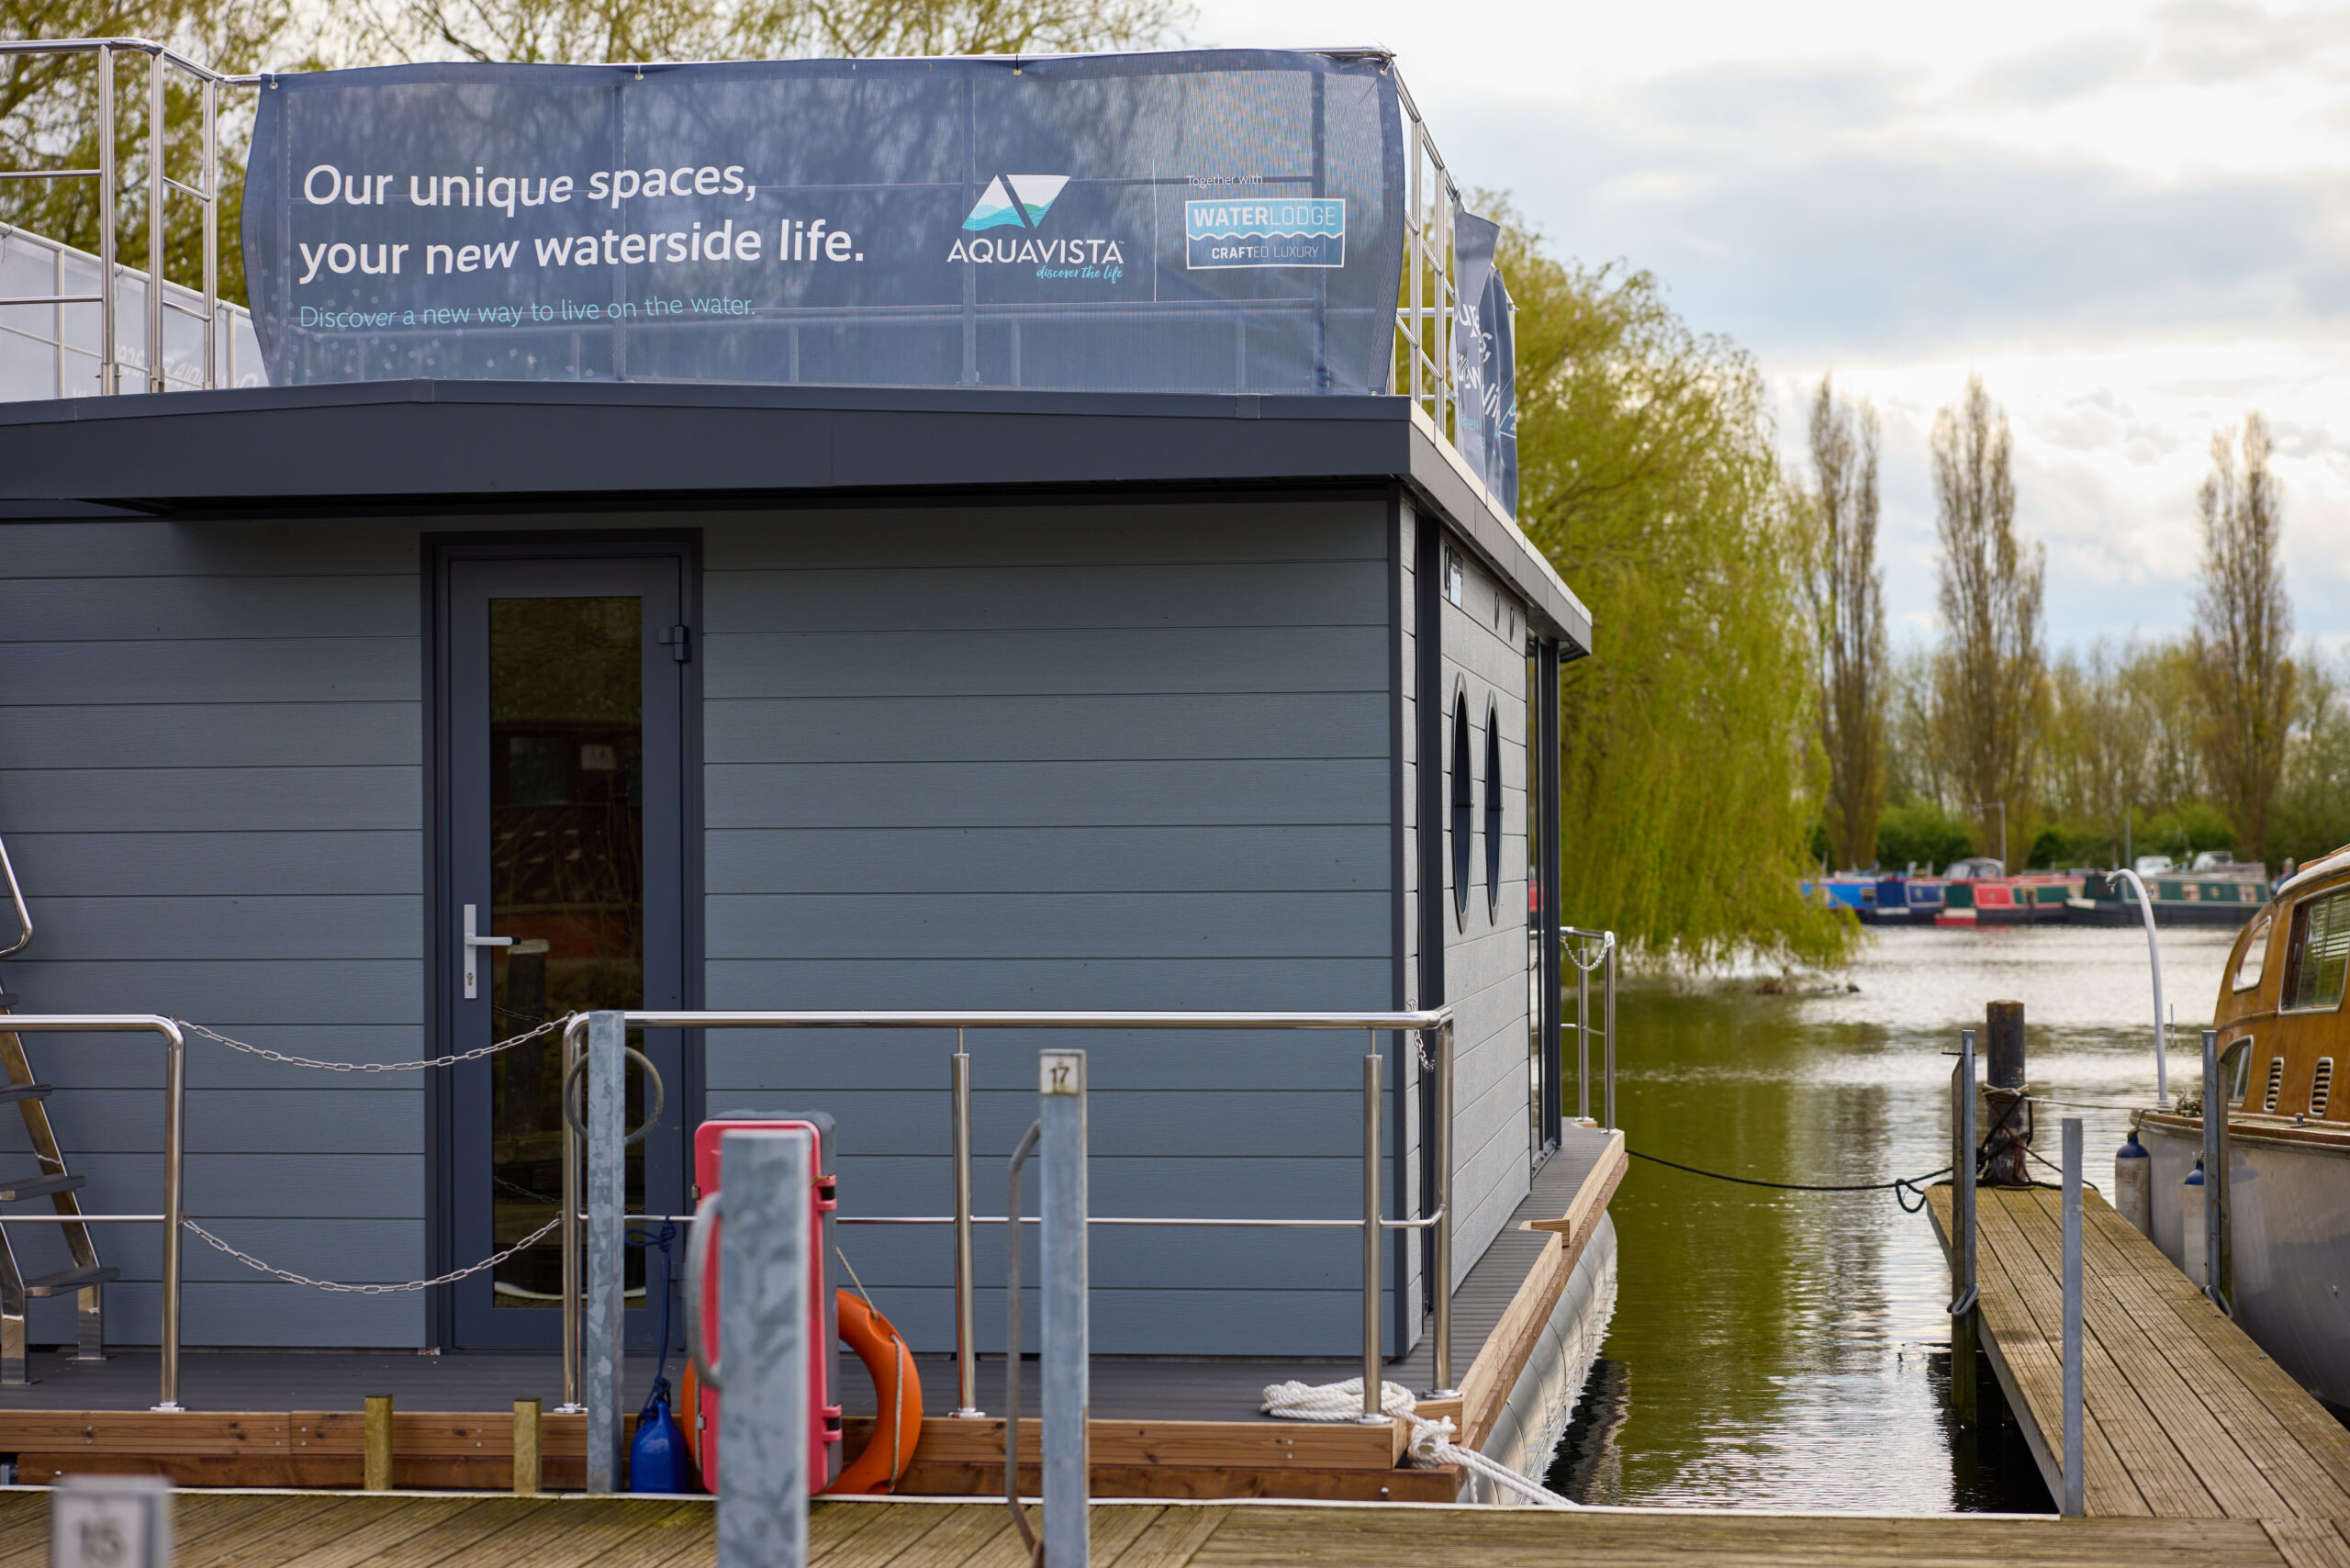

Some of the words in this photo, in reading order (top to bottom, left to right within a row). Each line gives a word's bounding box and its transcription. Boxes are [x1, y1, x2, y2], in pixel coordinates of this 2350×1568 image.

[304, 164, 393, 205] Our
[410, 165, 574, 218] unique
[588, 165, 755, 209] spaces,
[1186, 174, 1236, 188] Together
[1239, 174, 1263, 185] with
[1193, 206, 1337, 228] WATERLODGE
[299, 242, 408, 285] your
[426, 240, 520, 274] new
[534, 219, 762, 266] waterside
[780, 218, 864, 263] life.
[1212, 246, 1269, 260] CRAFTED
[1273, 245, 1319, 258] LUXURY
[1036, 264, 1080, 280] discover
[1103, 264, 1124, 285] life
[300, 307, 397, 328] Discover
[402, 309, 416, 325] a
[423, 308, 470, 324] new
[477, 307, 523, 328] way
[531, 302, 554, 321] to
[562, 298, 599, 320] live
[607, 301, 637, 318] on
[644, 296, 683, 316] the
[690, 297, 755, 316] water.
[1050, 1066, 1070, 1087] 17
